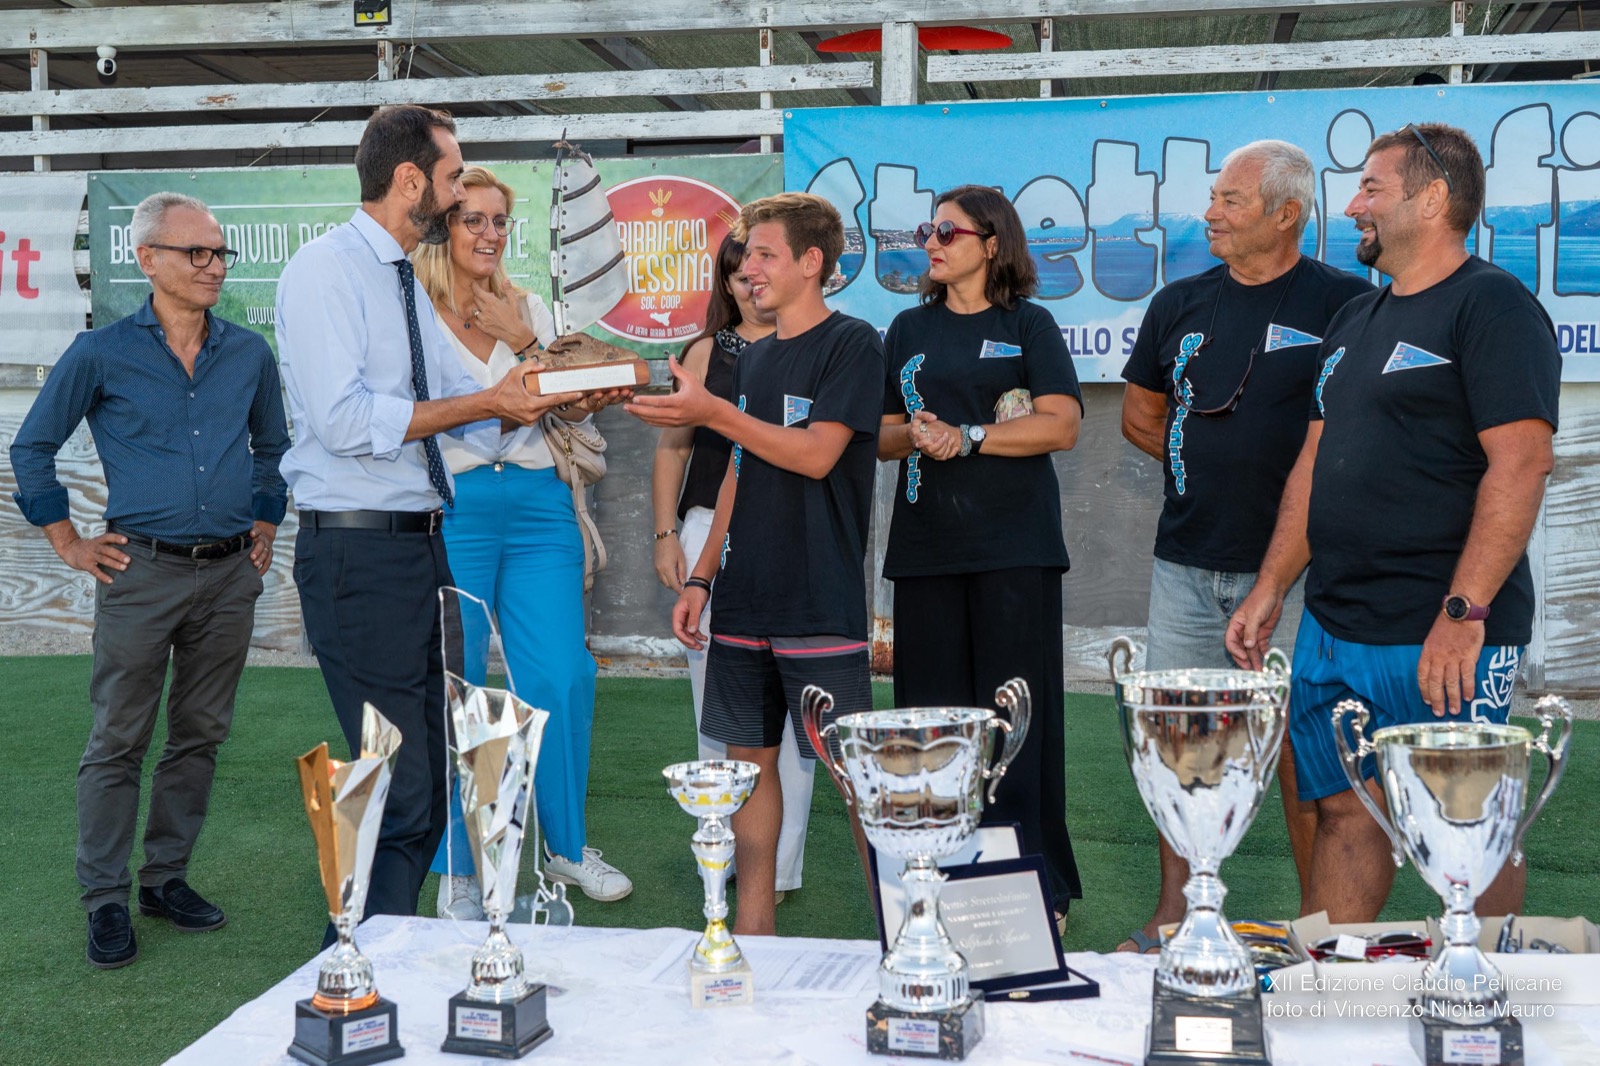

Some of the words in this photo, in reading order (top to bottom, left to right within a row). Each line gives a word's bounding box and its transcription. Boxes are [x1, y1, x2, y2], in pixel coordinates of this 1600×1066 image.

[616, 218, 708, 254] BIRRIFICIO
[640, 295, 658, 310] SOC.
[660, 294, 683, 309] COOP.
[673, 322, 699, 336] MESSINA
